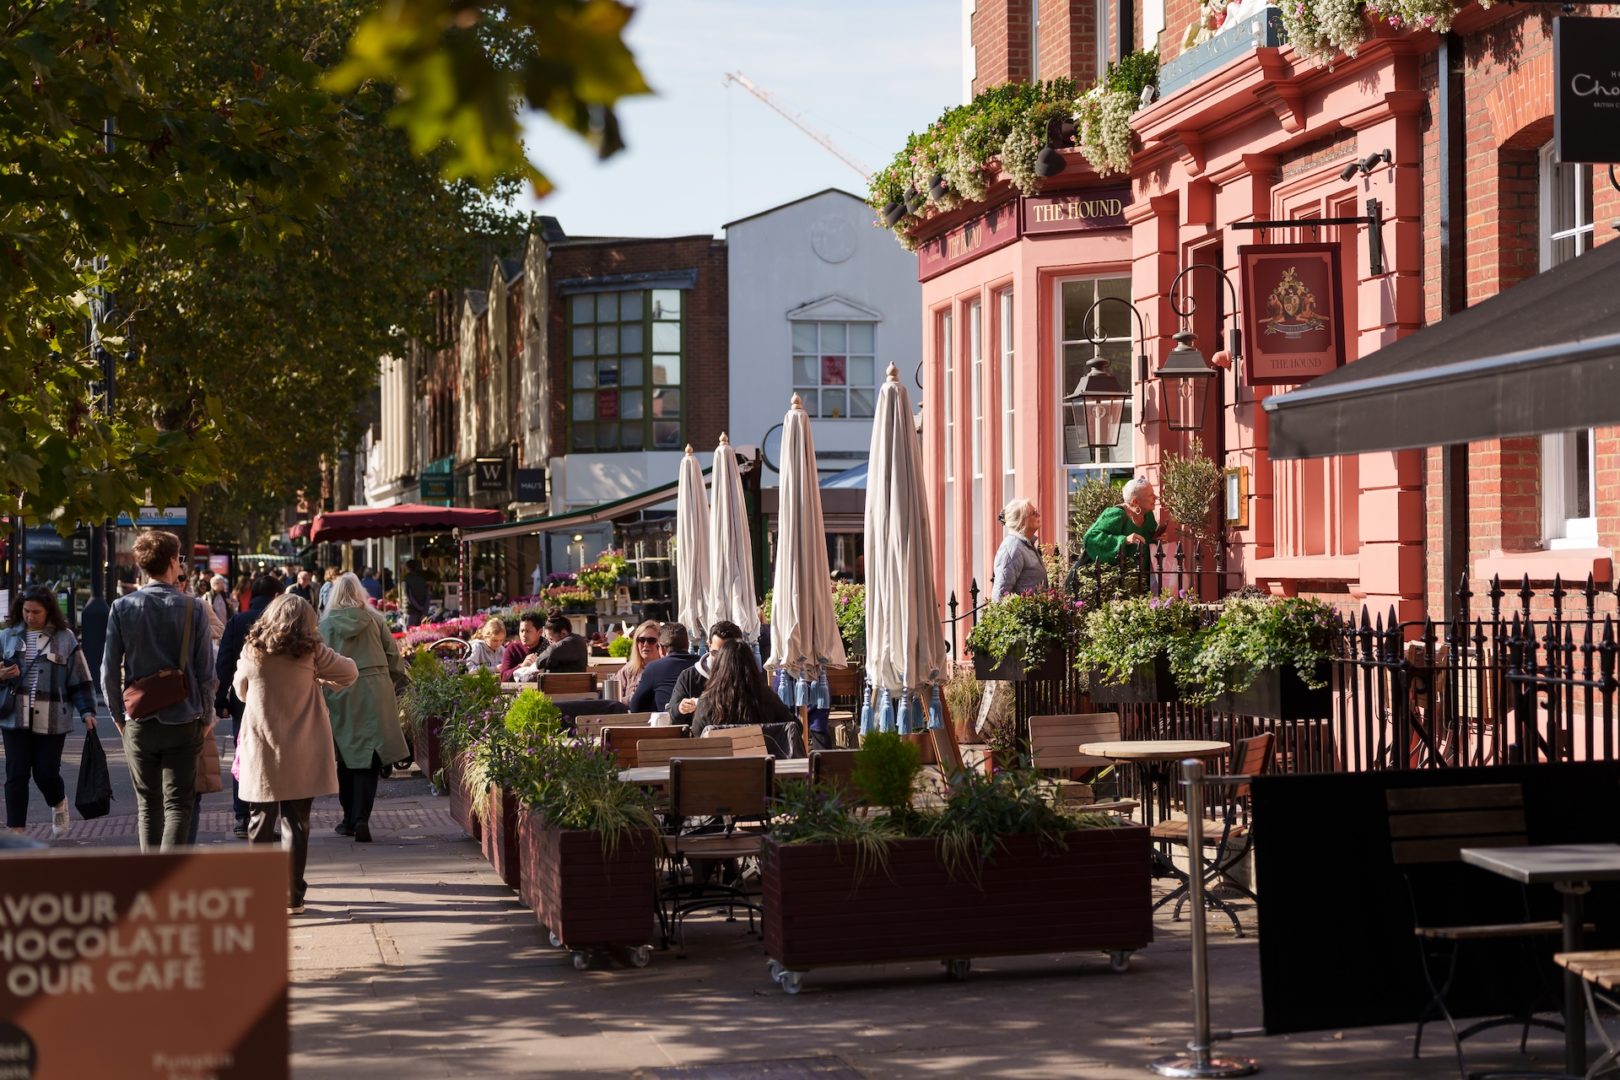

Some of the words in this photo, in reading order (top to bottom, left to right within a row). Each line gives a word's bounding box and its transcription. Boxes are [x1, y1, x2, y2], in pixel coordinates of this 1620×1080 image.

[1032, 203, 1064, 223] THE
[1068, 199, 1122, 220] HOUND
[1271, 359, 1289, 369] THE
[1291, 357, 1322, 369] HOUND
[482, 465, 501, 480] W
[72, 539, 87, 550] E3
[0, 893, 117, 925] VOUR
[129, 894, 155, 921] A
[169, 890, 251, 919] HOT
[213, 925, 254, 953] IN
[8, 966, 95, 997] OUR
[107, 957, 203, 991] CAFÉ
